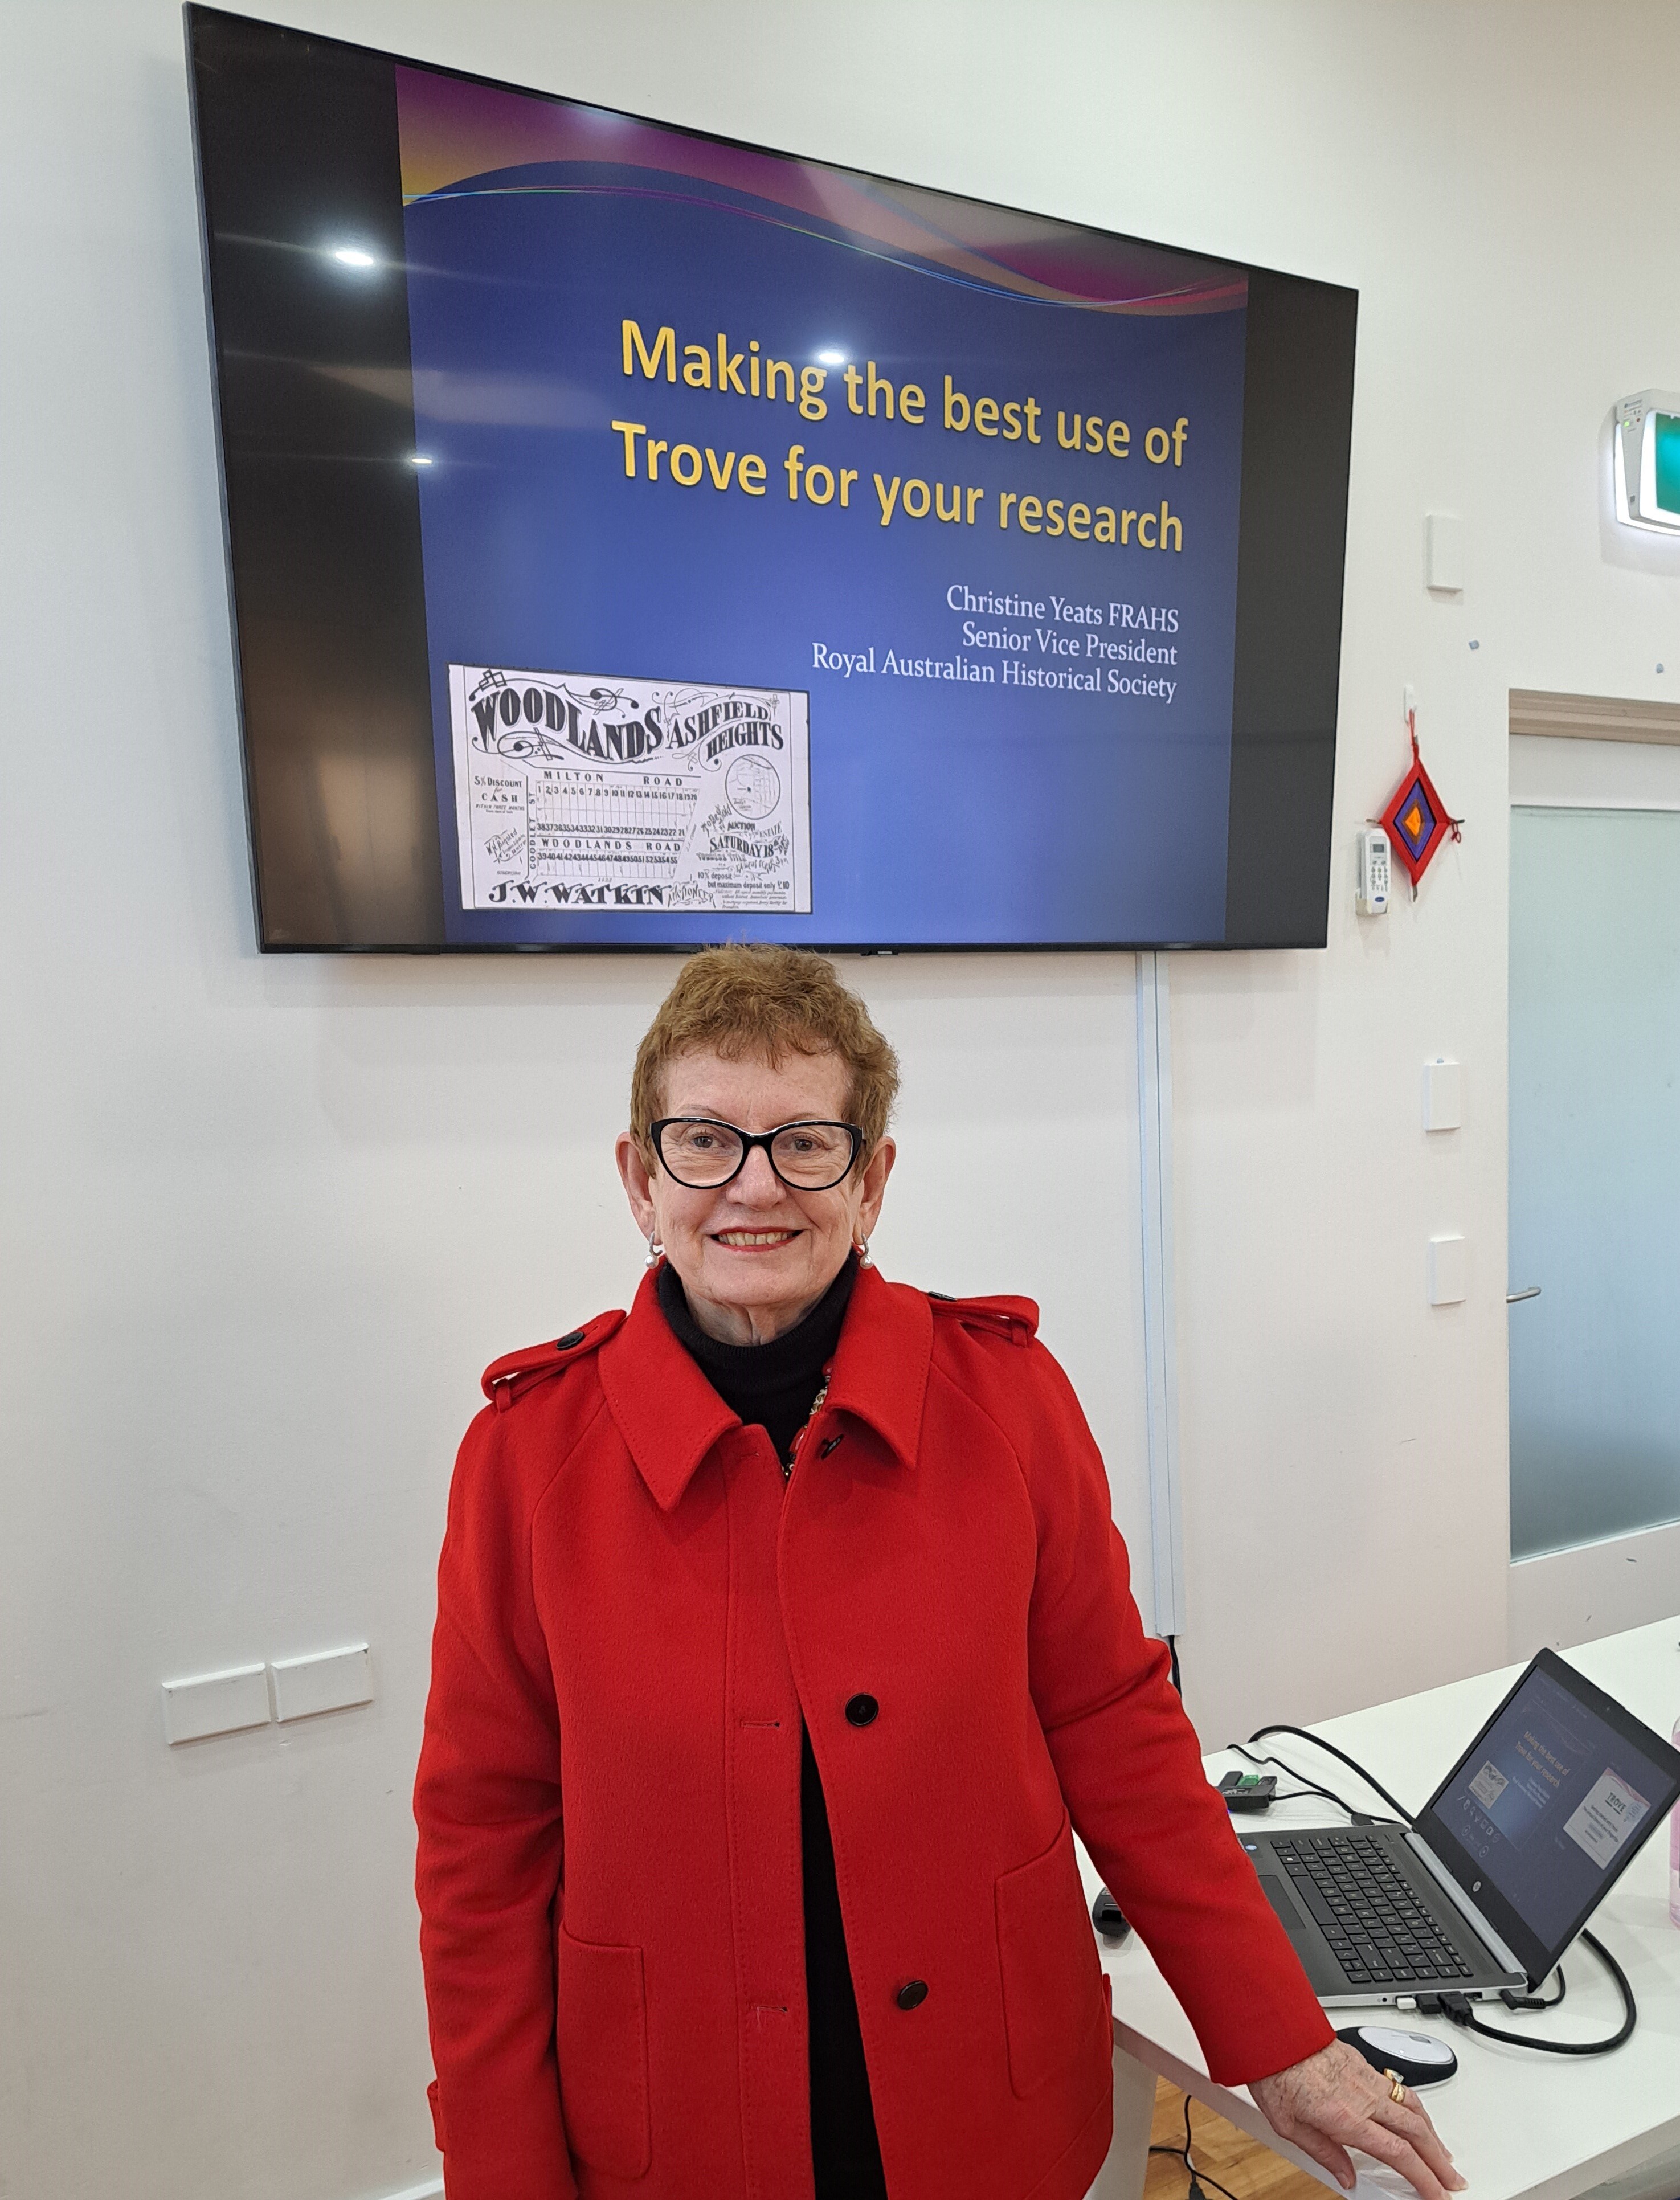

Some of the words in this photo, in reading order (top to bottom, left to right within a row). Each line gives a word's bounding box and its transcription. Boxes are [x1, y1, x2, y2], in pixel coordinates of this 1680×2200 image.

[622, 319, 828, 421] Making
[843, 361, 926, 424] the
[943, 375, 1041, 444] best
[1057, 411, 1130, 458] use
[1144, 417, 1189, 467] of
[611, 420, 767, 496] Trove
[784, 445, 858, 508] for
[873, 473, 984, 526] your
[999, 492, 1183, 552] research
[946, 584, 1045, 619] Christine
[1049, 595, 1103, 625] Yeats
[1108, 602, 1179, 633] FRAHS
[962, 621, 1031, 652] Senior
[1035, 628, 1080, 657] Vice
[1085, 633, 1178, 666] President
[812, 641, 876, 678] Royal
[881, 648, 996, 684] Australian
[1001, 659, 1102, 692] Historical
[1107, 669, 1177, 704] Society
[471, 687, 664, 761] WOODLANDS
[665, 701, 769, 750] ASHFIELD
[706, 721, 784, 762] HEIGHTS
[543, 770, 603, 782] MILTON
[643, 776, 682, 786] ROAD
[481, 792, 518, 803] CASH
[727, 821, 755, 831] AUCTION
[541, 838, 632, 850] WOODLANDS
[646, 842, 681, 852] ROAD
[710, 835, 763, 858] SATURDAY
[764, 844, 774, 858] 18
[711, 871, 733, 881] deposit
[743, 881, 762, 892] deposit
[763, 882, 775, 891] only
[1607, 1792, 1626, 1813] TROVE
